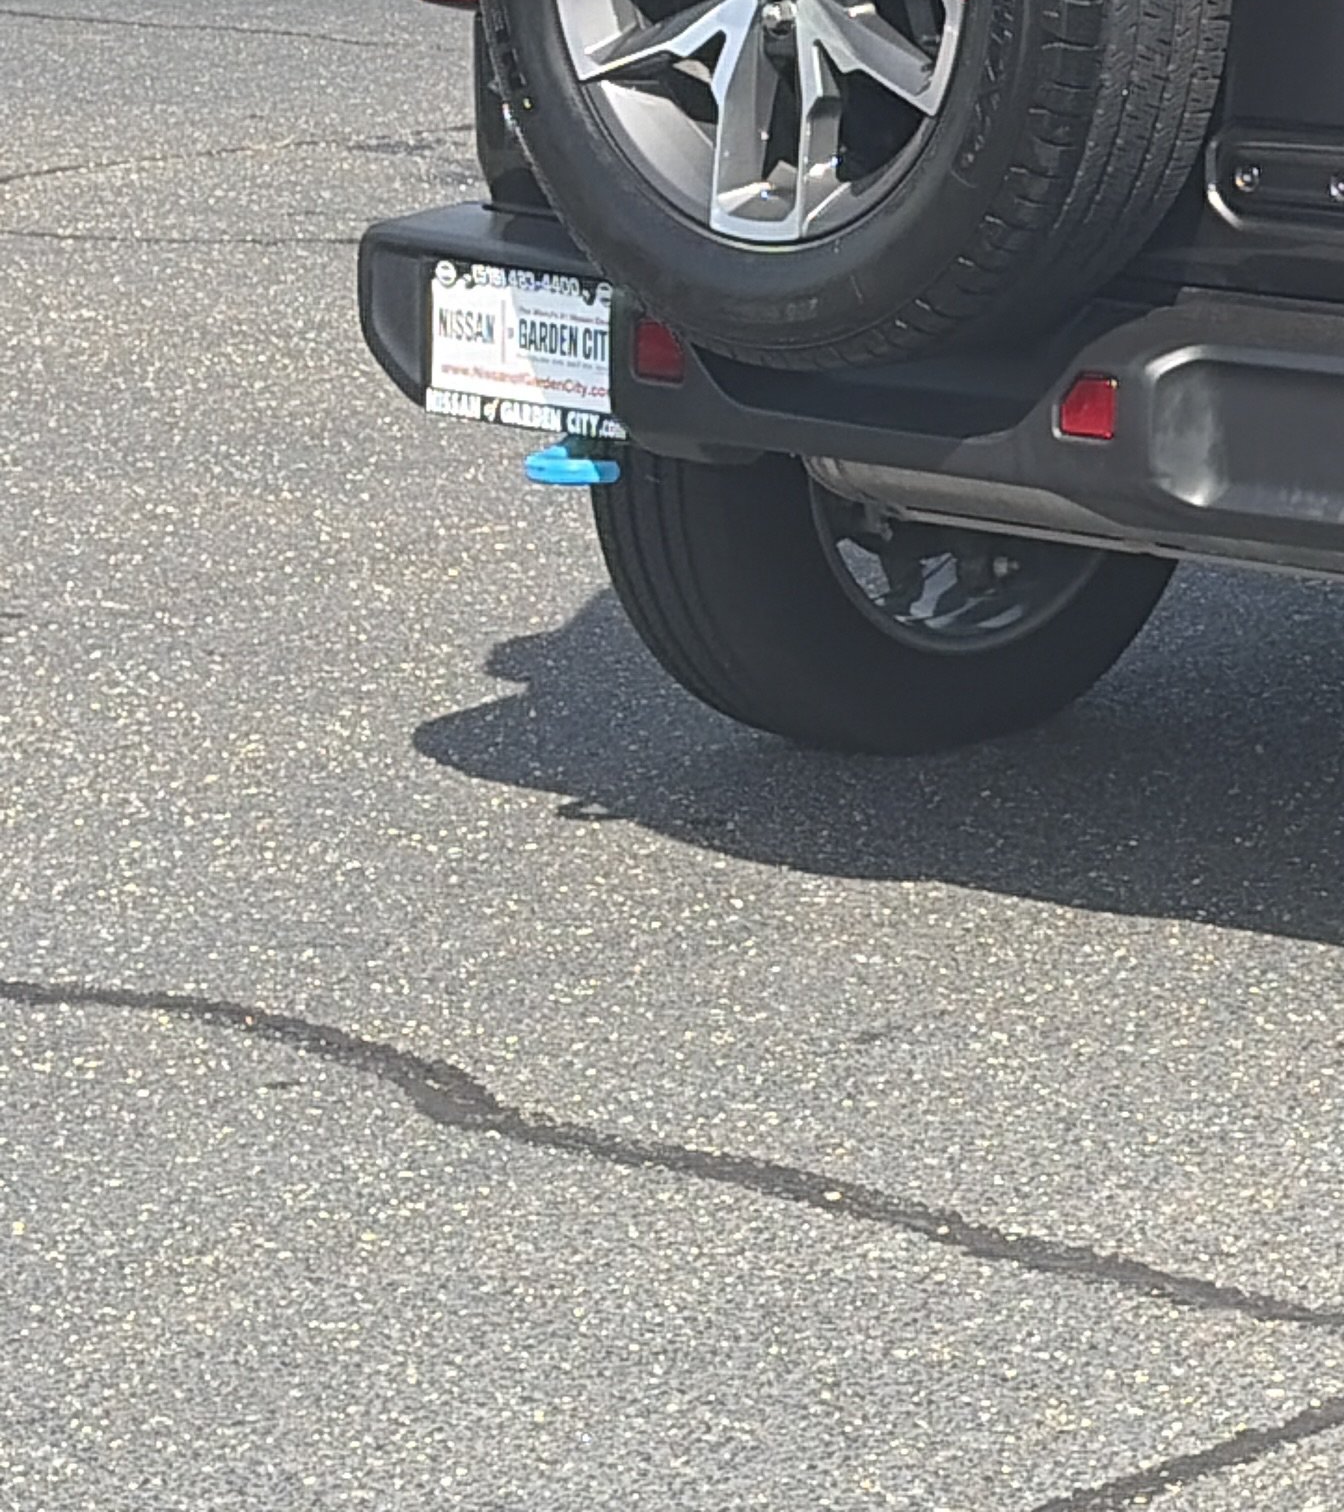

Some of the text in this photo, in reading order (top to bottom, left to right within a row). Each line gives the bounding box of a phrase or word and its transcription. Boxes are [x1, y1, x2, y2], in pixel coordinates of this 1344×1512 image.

[438, 307, 496, 345] NISSAN
[518, 317, 579, 358] GARDEN
[582, 327, 609, 363] CIT
[425, 388, 482, 420] NISSAN
[499, 400, 562, 433] GARDEN
